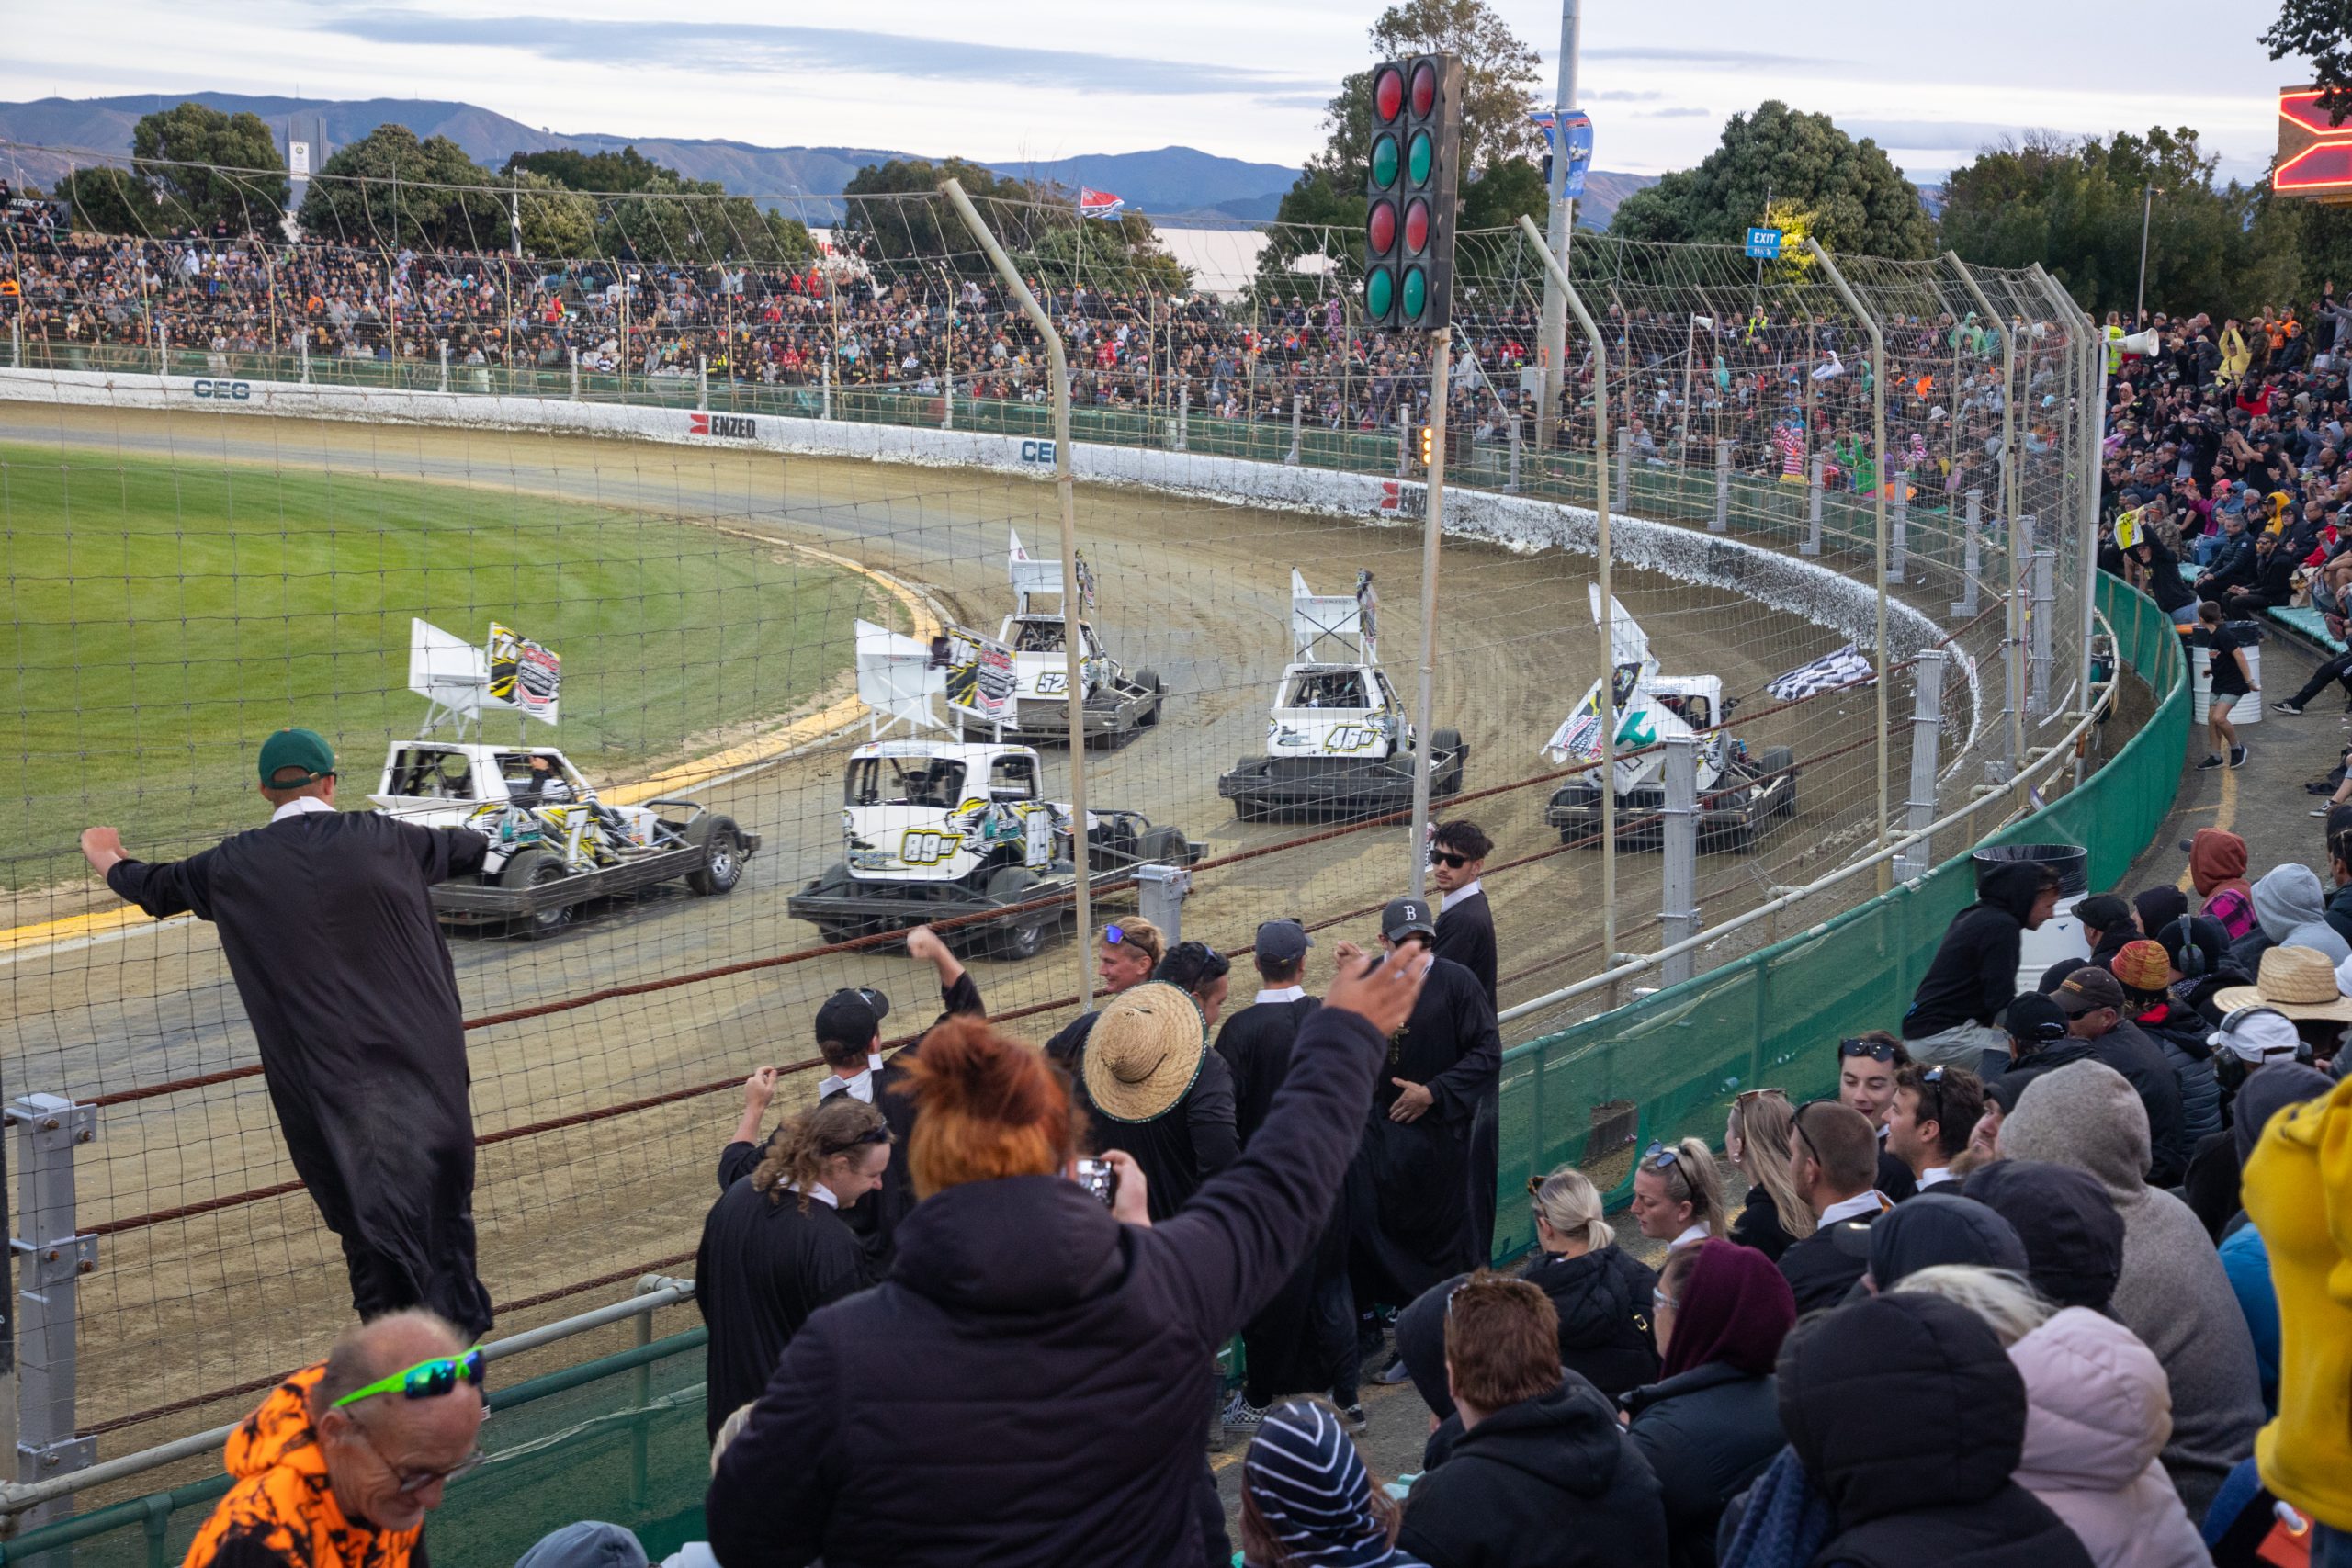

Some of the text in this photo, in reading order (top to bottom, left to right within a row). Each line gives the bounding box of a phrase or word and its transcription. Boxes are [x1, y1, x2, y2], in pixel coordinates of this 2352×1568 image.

[1753, 231, 1776, 244] EXIT
[711, 415, 756, 438] ENZED
[1022, 441, 1057, 463] CE
[1036, 672, 1068, 694] 52
[1404, 905, 1417, 921] B
